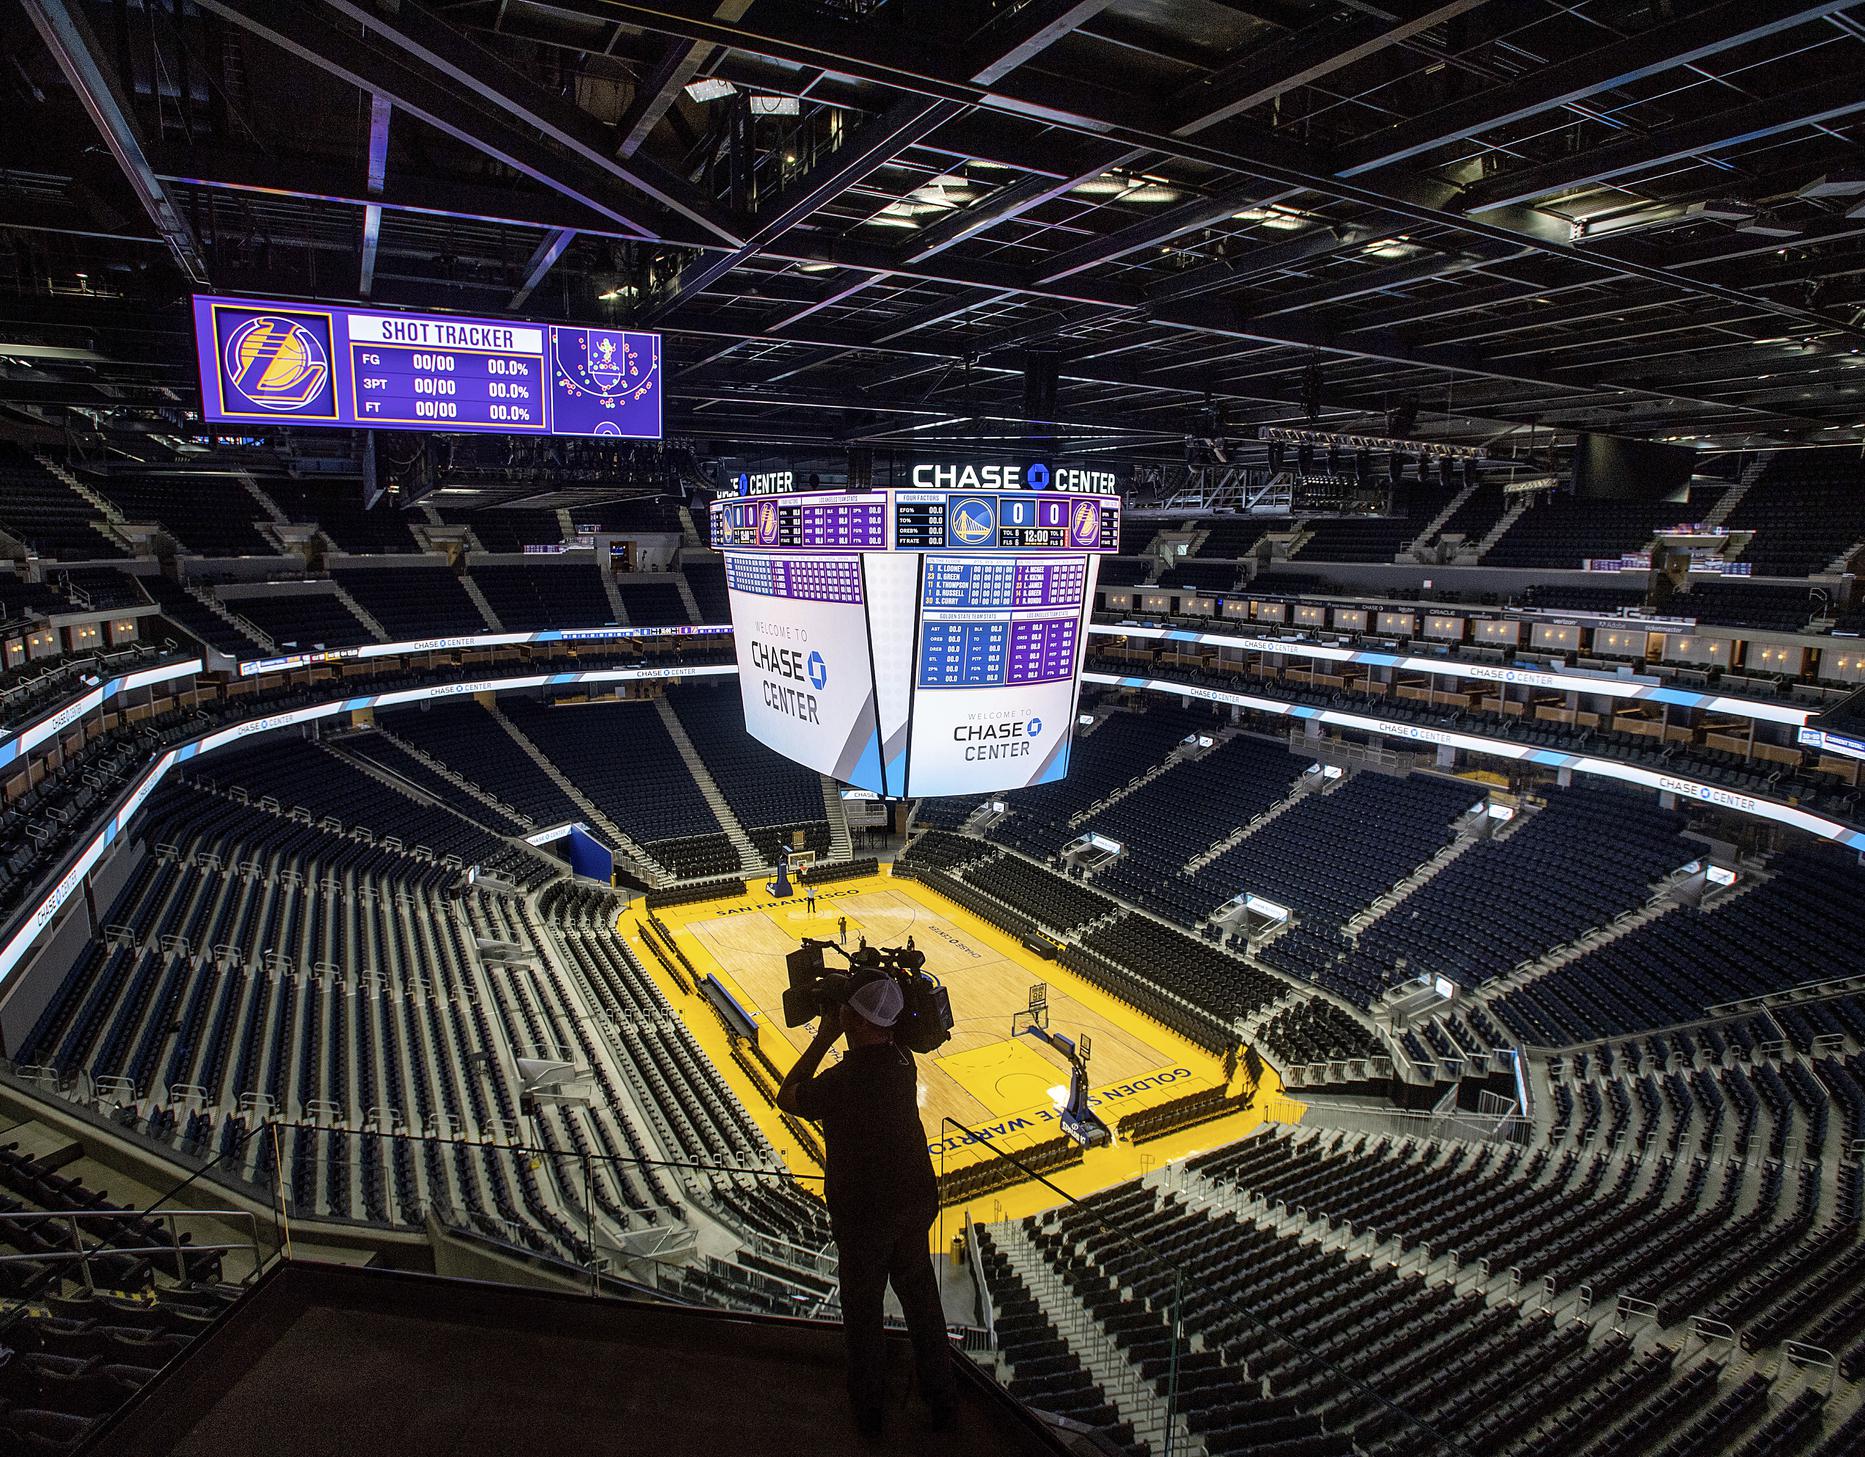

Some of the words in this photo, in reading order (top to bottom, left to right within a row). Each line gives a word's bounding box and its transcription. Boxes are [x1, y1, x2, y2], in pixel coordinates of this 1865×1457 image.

[382, 320, 428, 343] SHOT
[433, 324, 514, 349] TRACKER
[362, 354, 380, 366] FG
[413, 354, 455, 373] 00/00
[488, 359, 528, 376] 00.0%
[363, 379, 387, 391] 3PT
[414, 377, 456, 395] 00/00
[488, 381, 529, 399] 00.0%
[365, 402, 381, 413] FT
[415, 400, 457, 419] 00/00
[490, 404, 530, 421] 00.0%
[749, 471, 793, 494] CENTER
[912, 464, 1021, 489] CHASE
[1055, 469, 1116, 495] CENTER
[749, 507, 753, 525] 0
[929, 506, 942, 514] 00.0
[1013, 503, 1023, 523] 0
[1050, 504, 1059, 524] 0
[1024, 530, 1048, 542] 12:00
[755, 620, 792, 640] WELCOME
[794, 628, 808, 642] TO
[1645, 625, 1682, 633] ticketmaster
[414, 640, 438, 649] CHASE
[447, 638, 475, 647] CENTER
[1245, 641, 1267, 649] CHASE
[1276, 644, 1298, 653] CENTER
[751, 640, 806, 682] CHASE
[671, 668, 696, 676] CENTER
[1470, 667, 1504, 679] CHASE
[1517, 673, 1553, 686] CENTER
[430, 686, 455, 696] CHASE
[464, 682, 492, 693] CENTER
[1191, 688, 1211, 698] CHASE
[1218, 693, 1240, 703] CENTER
[763, 679, 820, 726] CENTER
[968, 710, 1017, 720] WELCOME
[1020, 708, 1033, 717] TO
[238, 724, 259, 736] CHASE
[269, 714, 293, 727] CENTER
[954, 722, 1024, 742] CHASE
[1379, 723, 1408, 735] CHASE
[1420, 730, 1451, 743] CENTER
[964, 742, 1030, 762] CENTER
[1660, 777, 1698, 796] CHASE
[1713, 791, 1755, 811] CENTER
[38, 895, 56, 927] CHASE
[62, 870, 77, 898] CENTER
[716, 906, 752, 916] SAN
[1102, 1068, 1192, 1100] GOLDEN
[928, 1118, 1034, 1154] WARRIO
